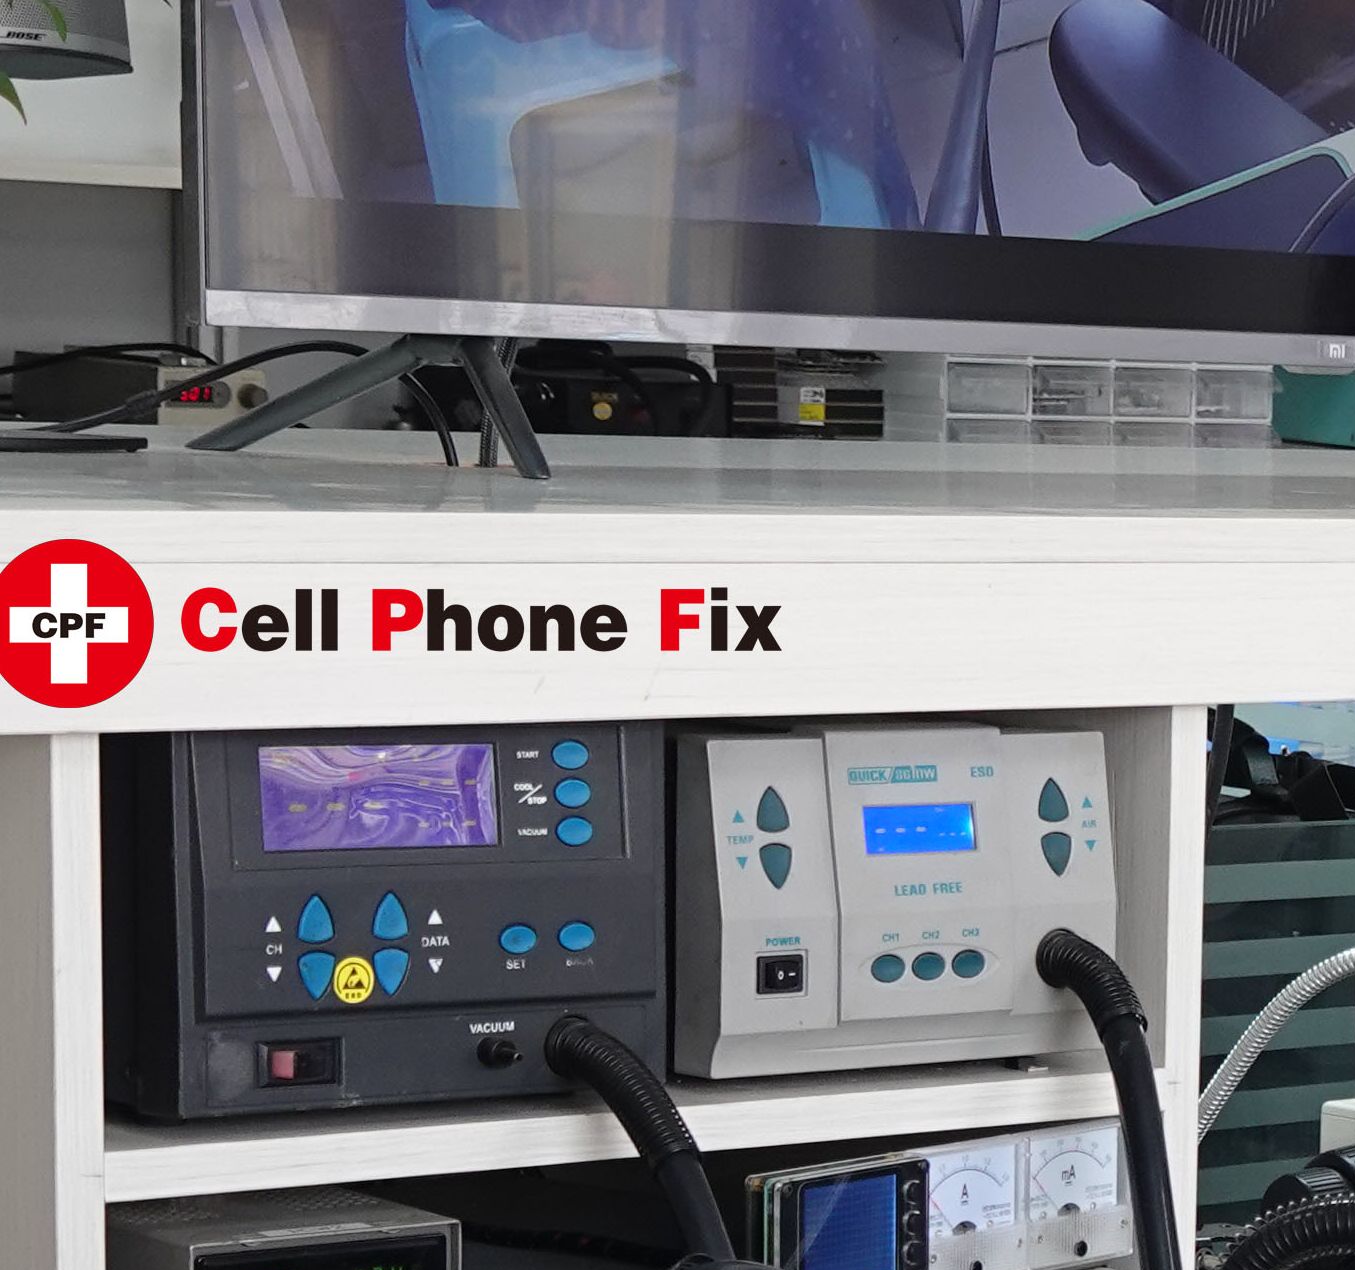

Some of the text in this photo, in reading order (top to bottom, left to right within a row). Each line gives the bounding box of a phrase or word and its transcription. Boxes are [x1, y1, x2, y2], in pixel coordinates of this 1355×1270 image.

[31, 612, 106, 640] CPF
[181, 587, 783, 653] Cell Phone Fix
[516, 750, 539, 759] START
[850, 770, 888, 784] QUICK
[970, 766, 994, 778] ESD
[894, 882, 963, 897] LEAD FREE
[421, 936, 450, 948] DATA
[765, 936, 801, 947] POWER
[266, 944, 283, 956] CH
[506, 959, 526, 970] SET
[469, 1021, 515, 1034] VACUUM
[1061, 1164, 1076, 1180] mA
[960, 1183, 969, 1199] A
